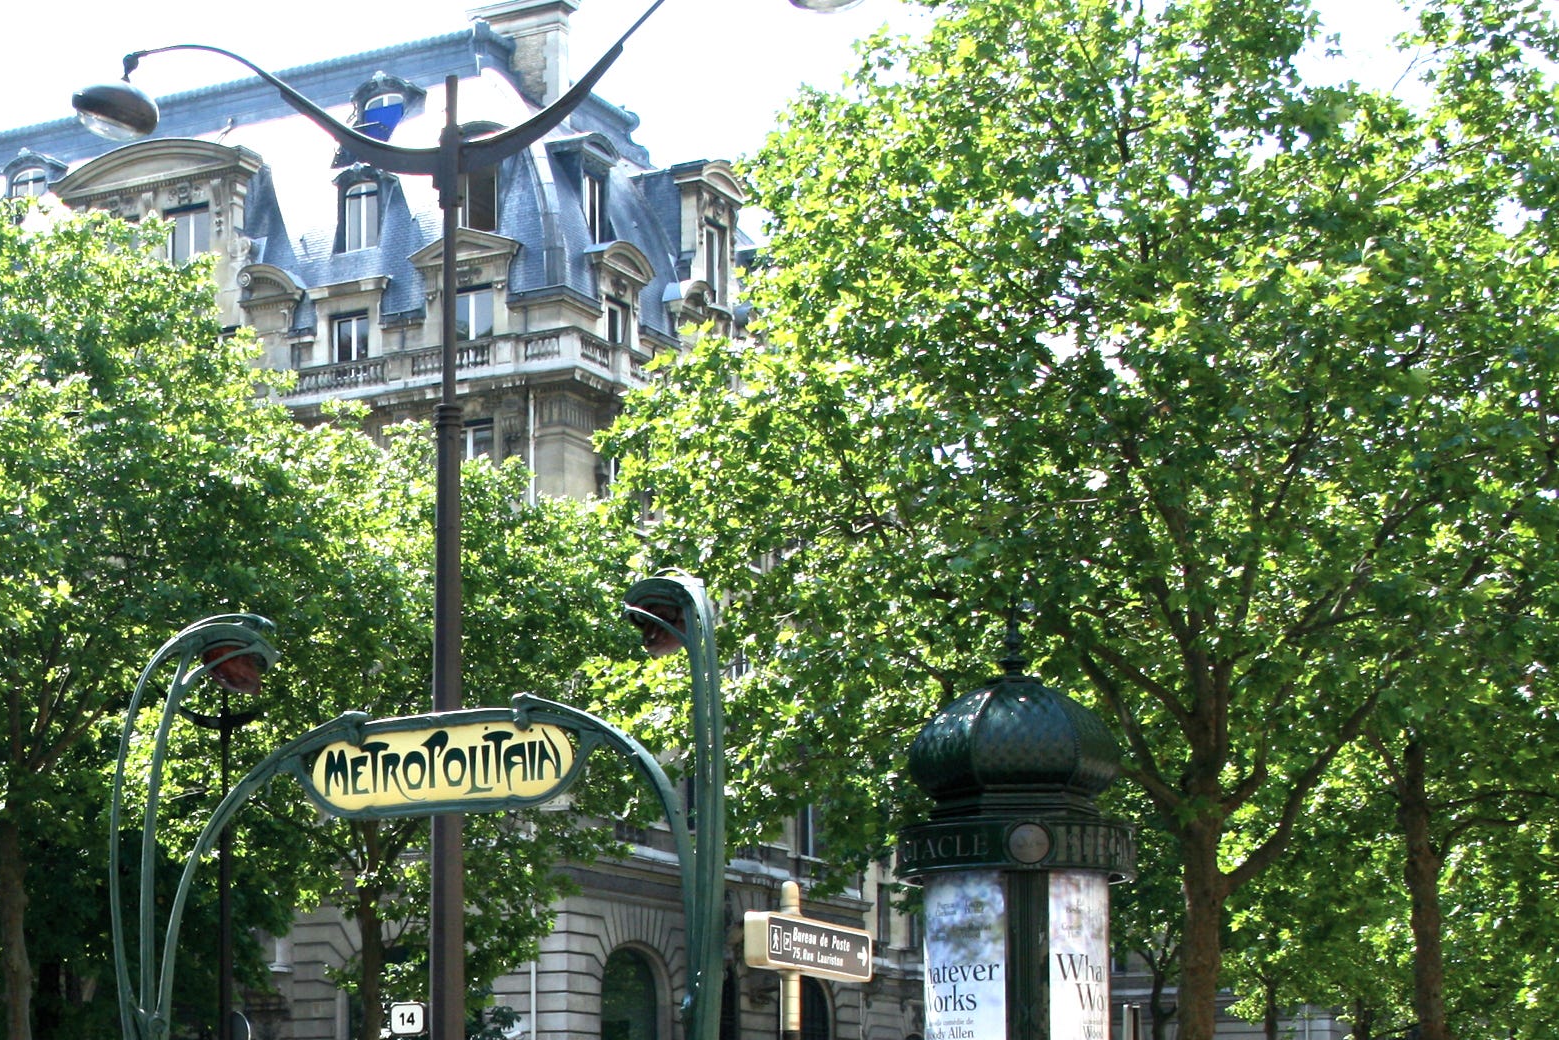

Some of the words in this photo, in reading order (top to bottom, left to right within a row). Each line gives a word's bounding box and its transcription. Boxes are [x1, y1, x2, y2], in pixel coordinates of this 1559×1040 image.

[323, 726, 562, 801] METROPOLITAIN
[792, 926, 817, 945] Bureau
[819, 932, 829, 948] de
[831, 934, 851, 952] Poste
[926, 958, 1000, 985] hatever
[1075, 983, 1107, 1012] Wo
[399, 1012, 416, 1026] 14
[948, 1026, 974, 1039] Allen
